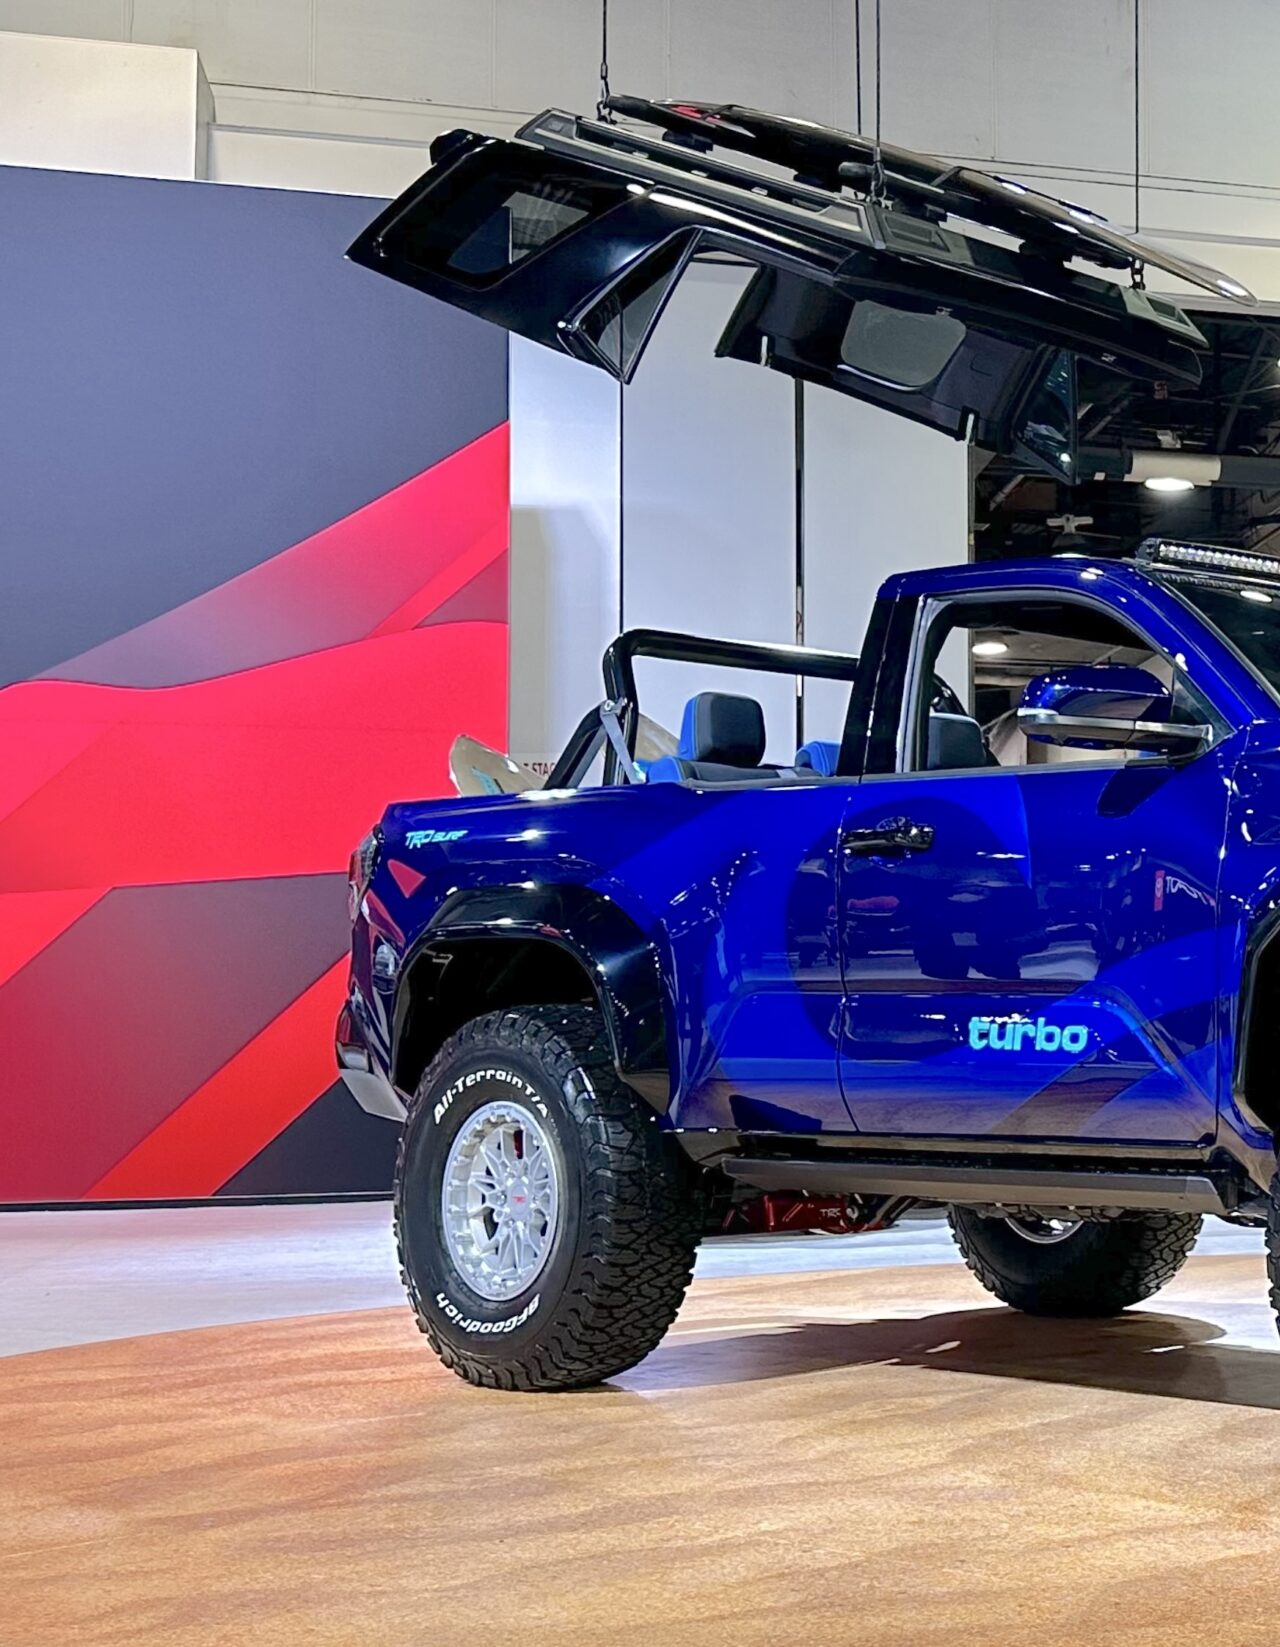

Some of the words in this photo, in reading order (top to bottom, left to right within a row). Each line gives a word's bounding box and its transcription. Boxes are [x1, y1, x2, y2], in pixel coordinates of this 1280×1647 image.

[968, 1016, 1089, 1052] turbo
[433, 1069, 523, 1125] All-Terrain
[524, 1083, 549, 1119] T/A
[436, 1292, 540, 1334] BFGoodrich
